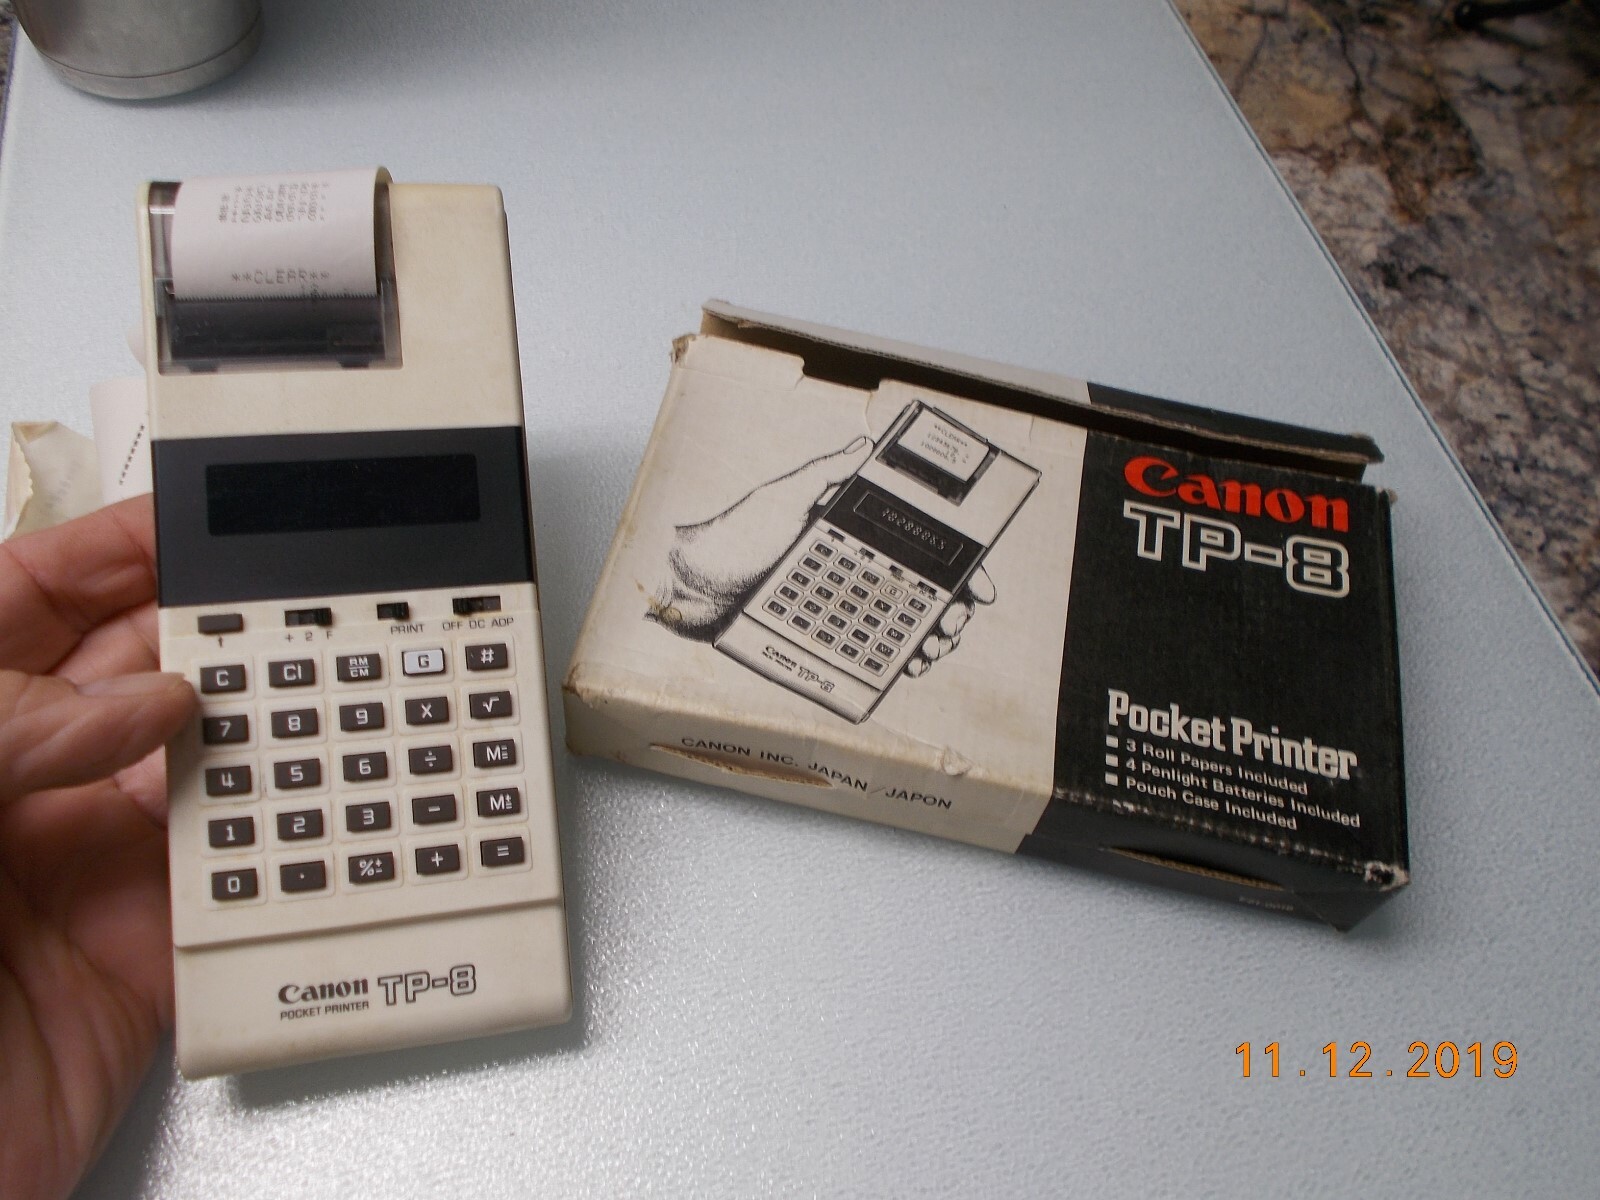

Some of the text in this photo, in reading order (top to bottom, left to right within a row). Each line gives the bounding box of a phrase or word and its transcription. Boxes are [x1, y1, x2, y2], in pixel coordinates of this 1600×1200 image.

[1123, 455, 1349, 533] Canon
[1123, 499, 1350, 598] TP-8
[390, 623, 425, 635] PRINT
[442, 621, 463, 632] OFF
[469, 619, 486, 629] DC
[418, 654, 430, 668] G
[216, 669, 230, 687] C
[350, 668, 369, 678] CM
[288, 716, 300, 732] 8
[355, 708, 368, 725] 9
[219, 722, 231, 736] 7
[1107, 688, 1358, 780] Pocket Printer
[290, 765, 303, 782] 5
[359, 758, 372, 775] 6
[681, 737, 751, 757] CANON
[760, 751, 799, 767] INC.
[808, 762, 868, 793] JAPAN
[885, 788, 953, 811] JAPON
[1126, 738, 1308, 796] 3 Roll Papers Included
[221, 772, 234, 788] 4
[1125, 757, 1361, 828] 4 Penlight Batteries Included
[1126, 776, 1298, 831] Pouch Case Included
[293, 816, 306, 833] 2
[363, 808, 374, 825] 3
[226, 825, 236, 841] 1
[228, 876, 240, 894] 0
[278, 964, 477, 1007] Canon TP-8
[280, 1001, 370, 1021] POCKET PRINTER
